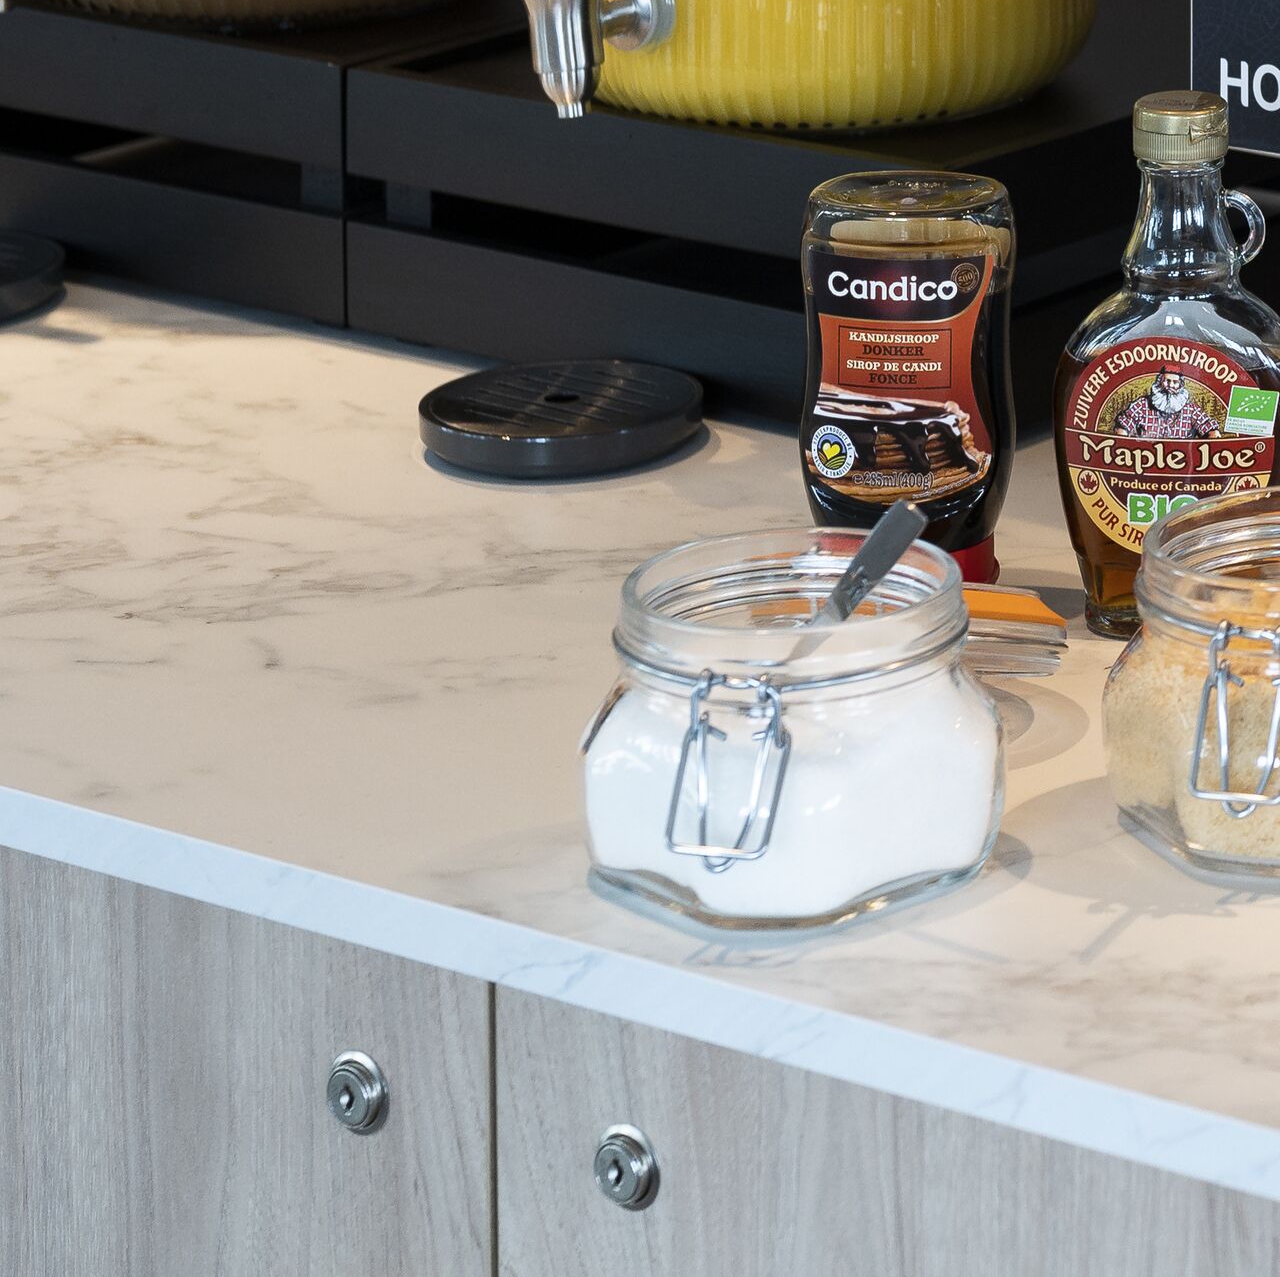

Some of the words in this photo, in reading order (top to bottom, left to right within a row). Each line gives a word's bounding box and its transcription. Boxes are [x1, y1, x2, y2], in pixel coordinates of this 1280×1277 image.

[827, 271, 958, 302] Candico
[848, 331, 940, 344] KANDIJSIROOP
[862, 344, 925, 357] DONKER
[846, 359, 881, 371] SIROP
[883, 361, 900, 371] DE
[902, 361, 943, 372] CANDI
[1074, 365, 1110, 430] ZUIVERE
[1105, 343, 1238, 385] ESDOORNSIROOP
[1079, 435, 1186, 475] Maple
[1110, 476, 1158, 491] Produce
[1160, 479, 1174, 491] of
[1175, 481, 1222, 492] Canada
[1092, 497, 1120, 530] PUR
